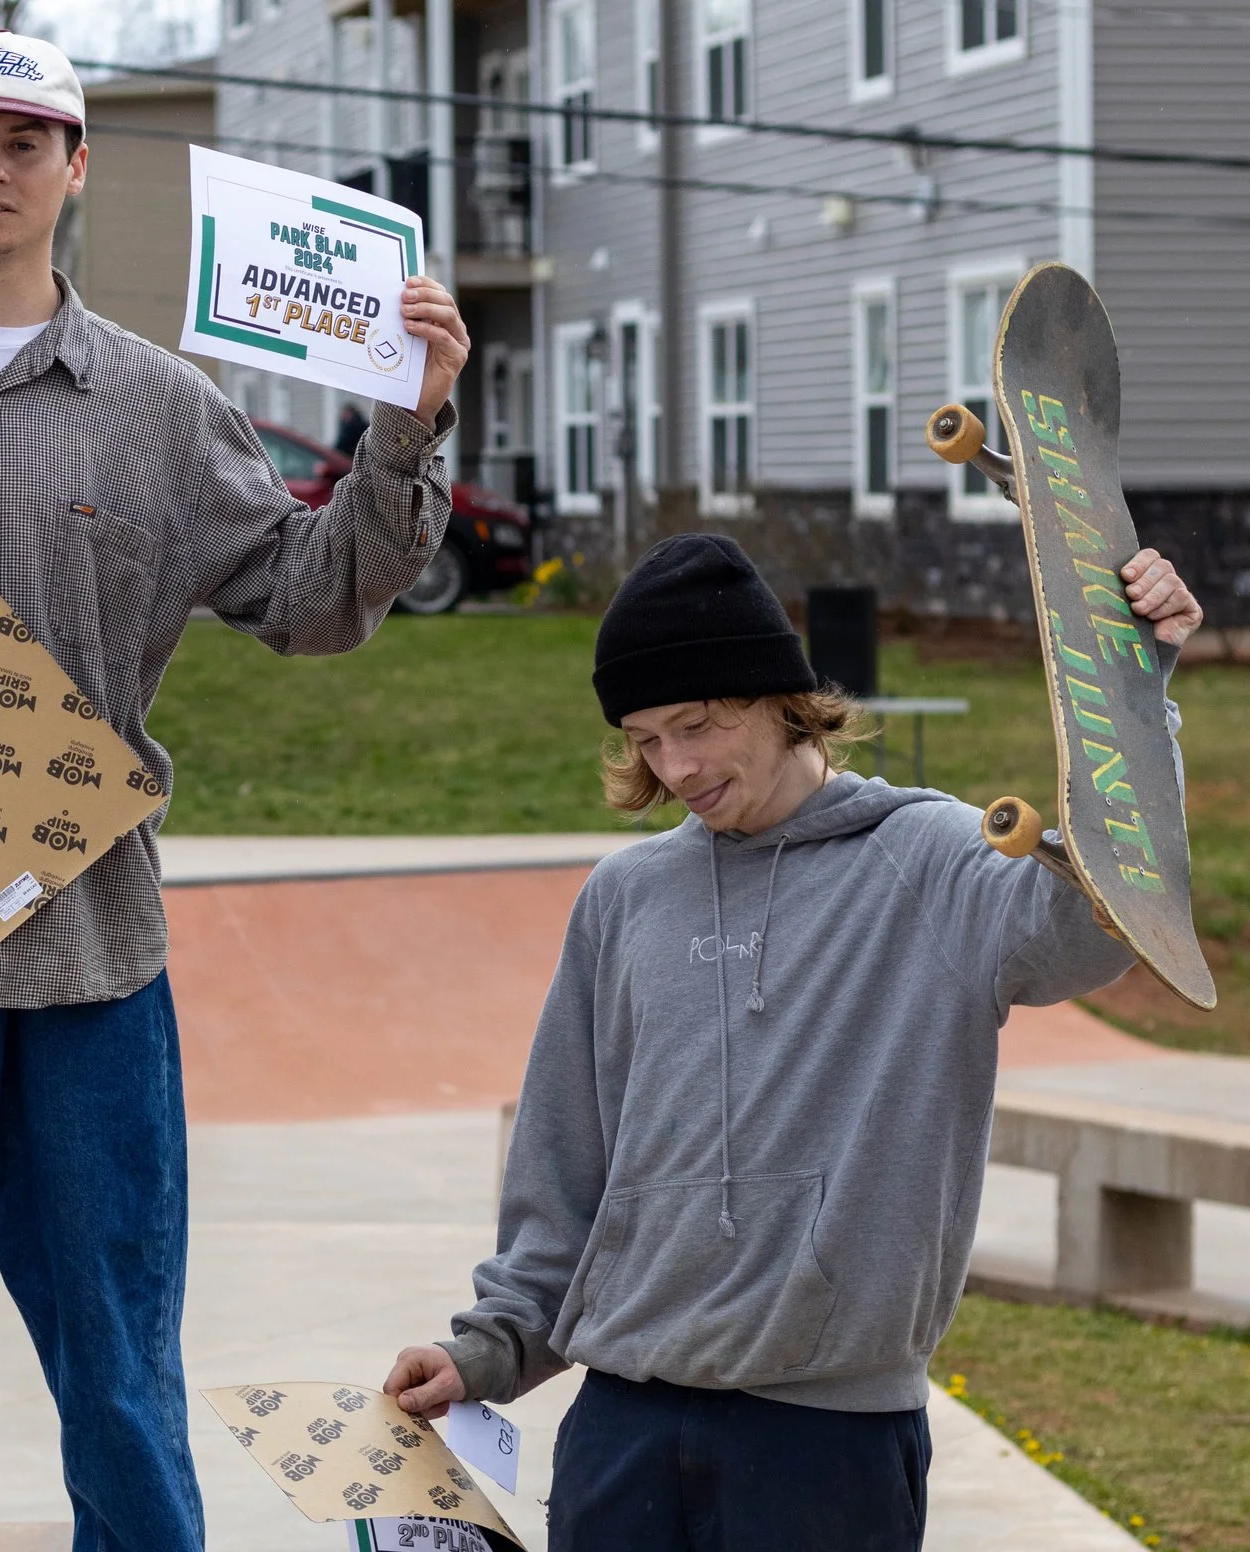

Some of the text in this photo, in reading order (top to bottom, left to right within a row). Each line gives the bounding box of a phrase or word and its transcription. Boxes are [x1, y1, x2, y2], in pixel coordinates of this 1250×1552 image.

[270, 222, 357, 262] PARK SLAM
[302, 222, 325, 235] WISE
[294, 248, 333, 274] 2024
[242, 264, 380, 319] ADVANCED
[246, 293, 369, 344] 1ST PLACE
[1022, 390, 1153, 674] SHAKE
[47, 759, 102, 790] MOB
[32, 824, 87, 855] MOB
[250, 1390, 289, 1417] MOB
[336, 1392, 371, 1412] MOB
[311, 1419, 349, 1445] MOB
[284, 1454, 324, 1482] MOB
[372, 1452, 408, 1475] MOB
[346, 1484, 384, 1510] MOB
[398, 1523, 430, 1547] 2ND
